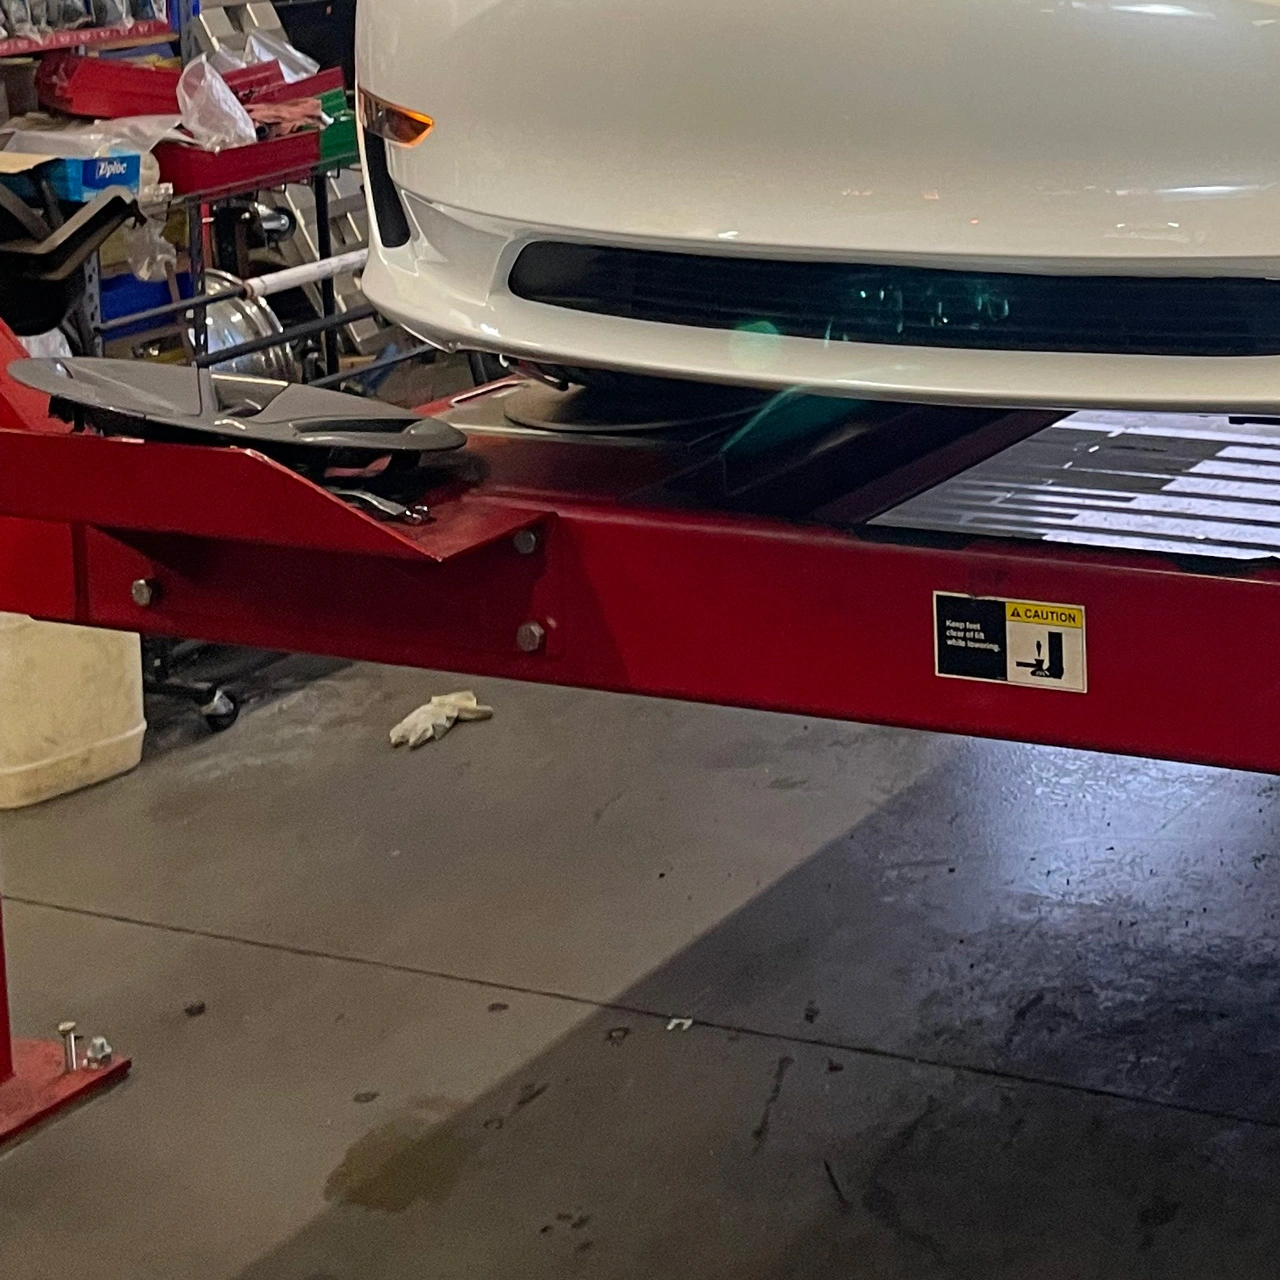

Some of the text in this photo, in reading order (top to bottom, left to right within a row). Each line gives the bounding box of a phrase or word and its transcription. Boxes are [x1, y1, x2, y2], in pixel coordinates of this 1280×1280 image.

[98, 161, 127, 178] Ziploc
[1024, 608, 1076, 624] CAUTION
[945, 619, 965, 629] Keep
[946, 629, 965, 638] clear
[965, 631, 974, 639] of
[946, 638, 966, 647] while
